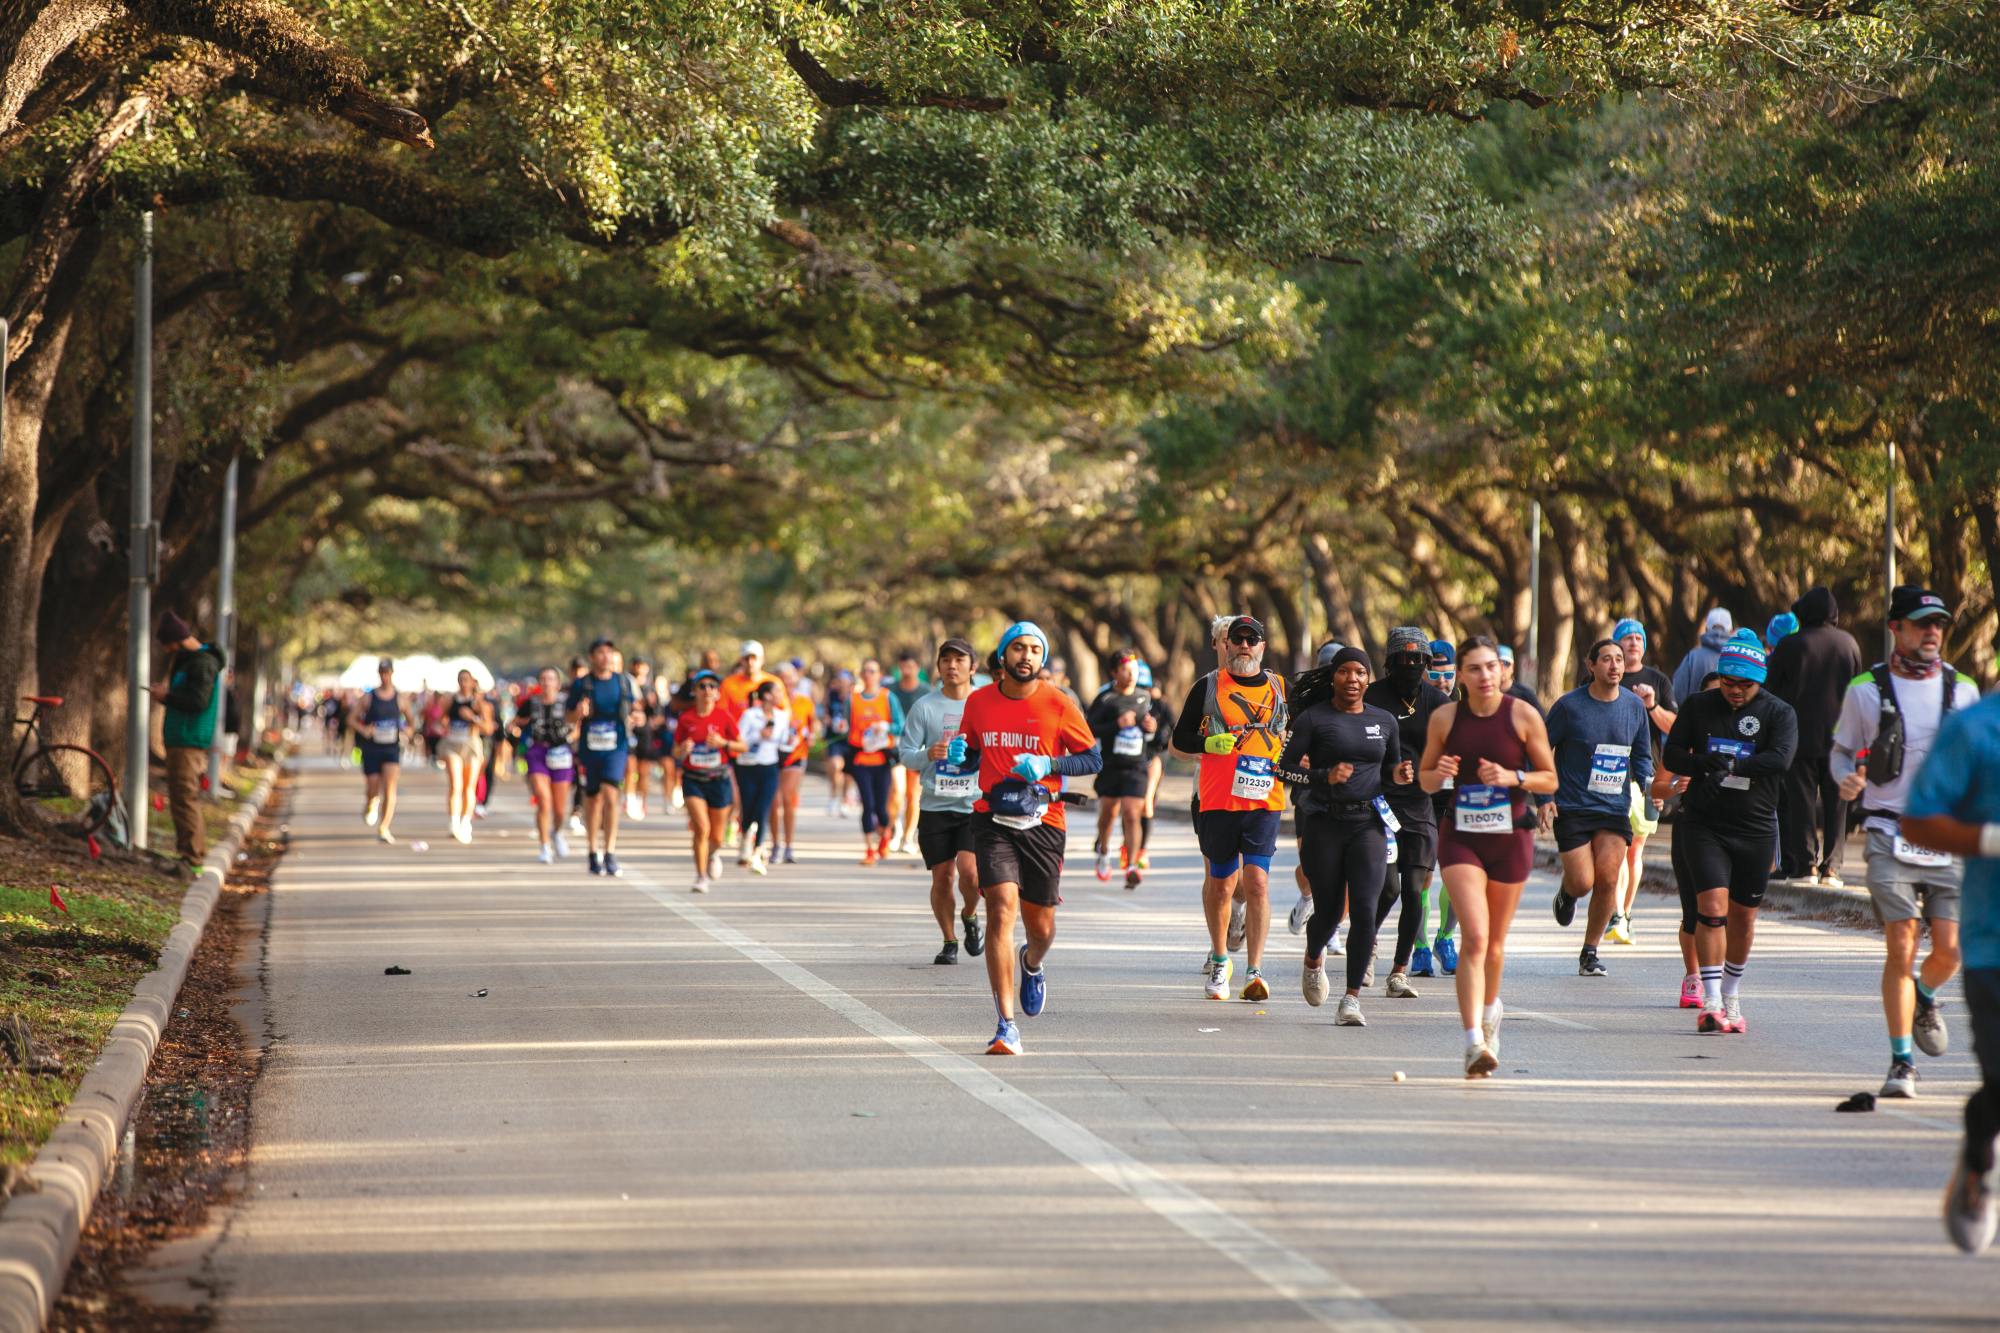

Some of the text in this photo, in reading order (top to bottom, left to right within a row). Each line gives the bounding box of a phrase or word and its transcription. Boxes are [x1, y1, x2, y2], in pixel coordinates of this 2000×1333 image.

[982, 731, 1040, 750] WE RUN UT
[1237, 776, 1271, 789] D12339
[1286, 771, 1311, 785] 2026
[1463, 812, 1505, 824] E16076
